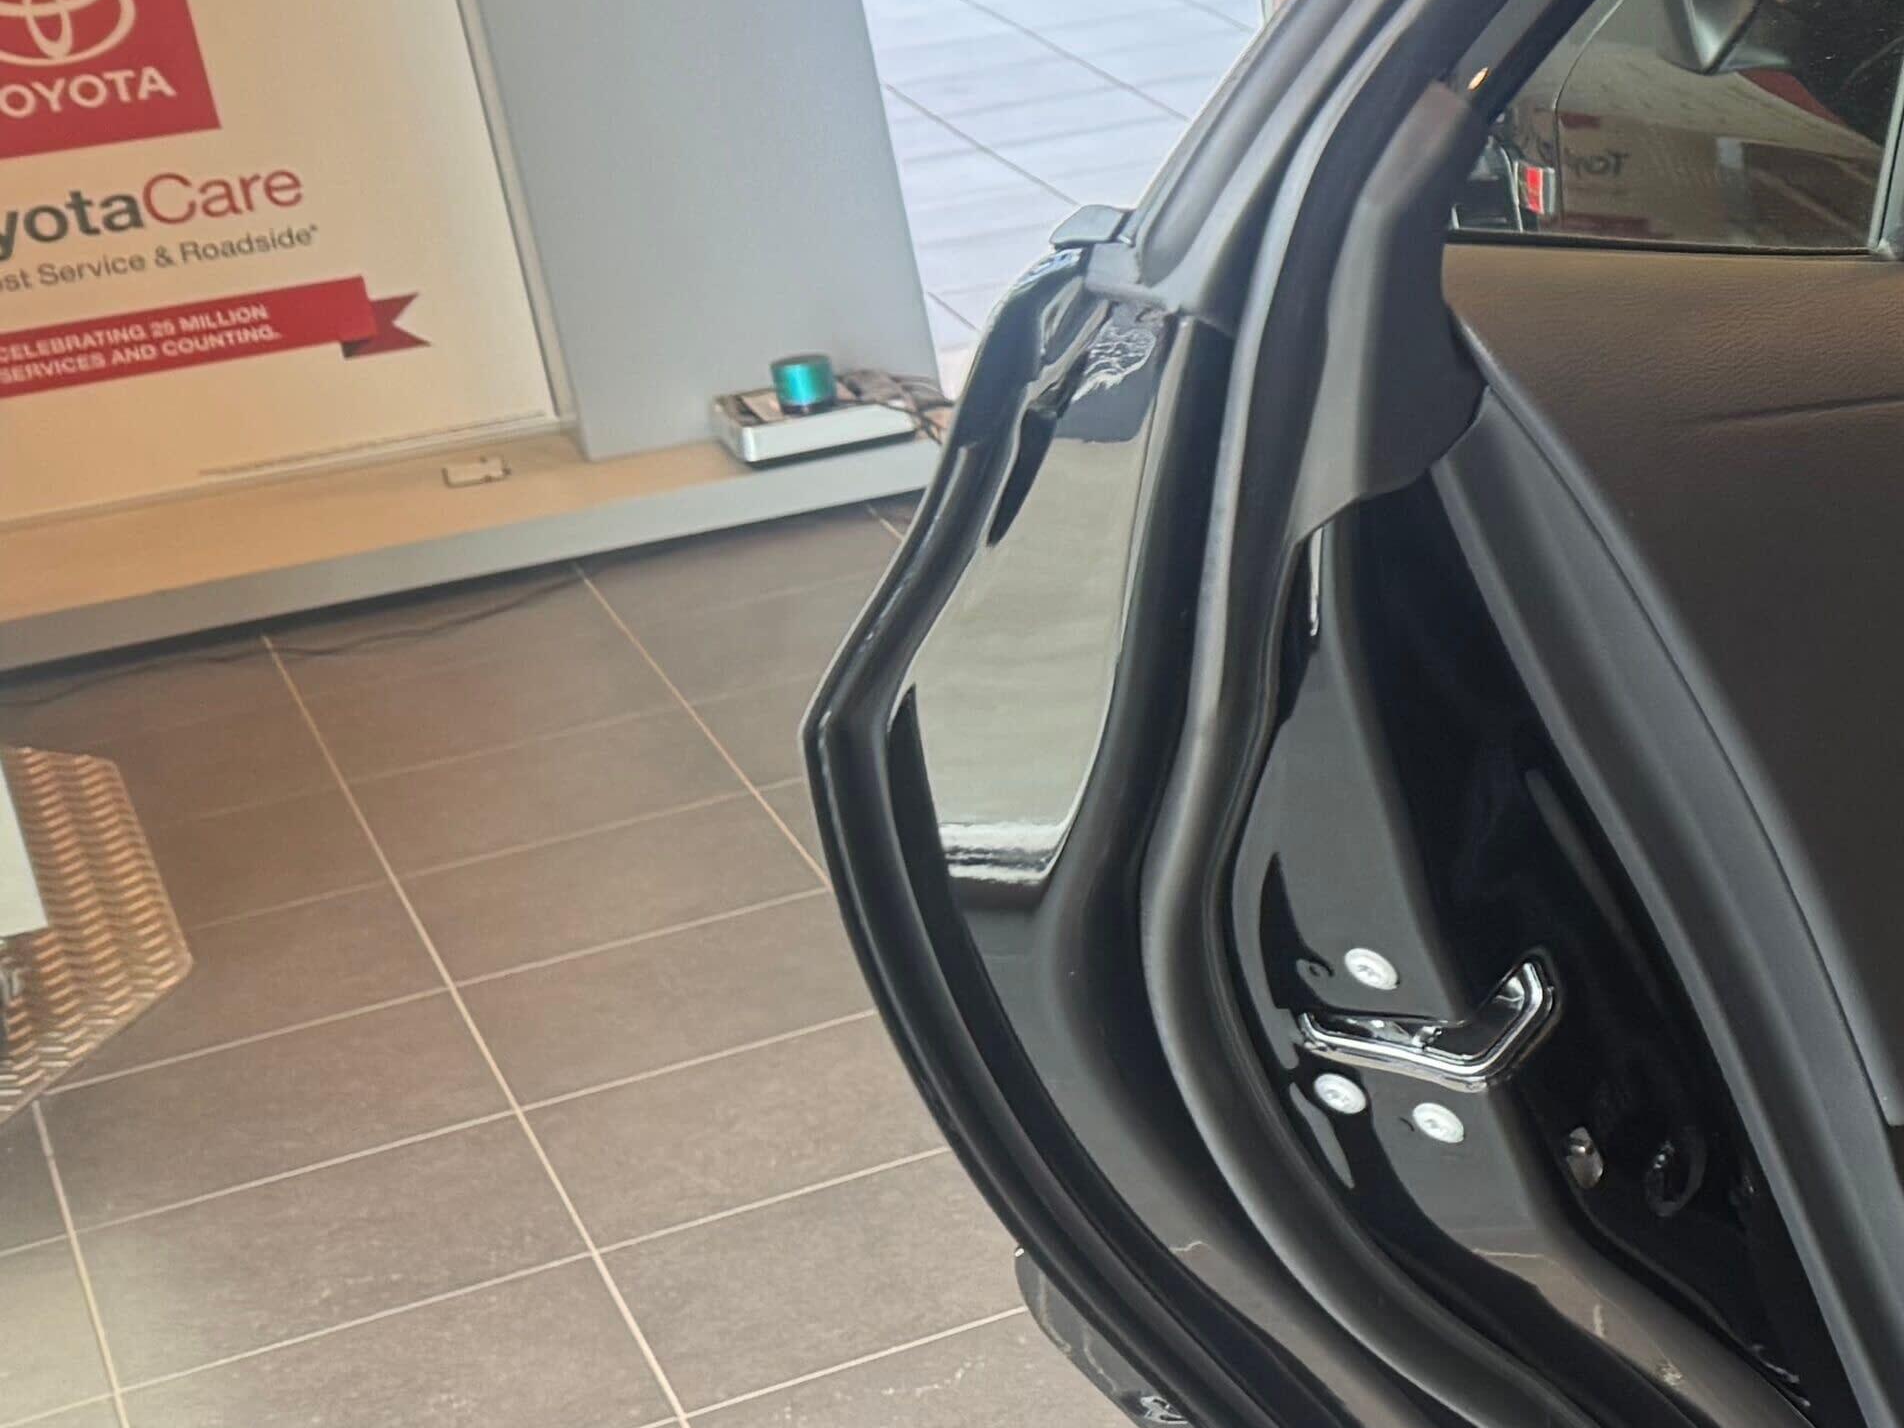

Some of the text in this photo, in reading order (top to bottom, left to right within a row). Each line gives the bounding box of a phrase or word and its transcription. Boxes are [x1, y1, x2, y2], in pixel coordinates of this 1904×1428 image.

[0, 65, 176, 118] OYOTA
[0, 169, 304, 262] yotaCare
[37, 253, 146, 286] Service
[154, 244, 175, 268] &
[178, 304, 269, 334] MILLION
[110, 342, 157, 366] AND
